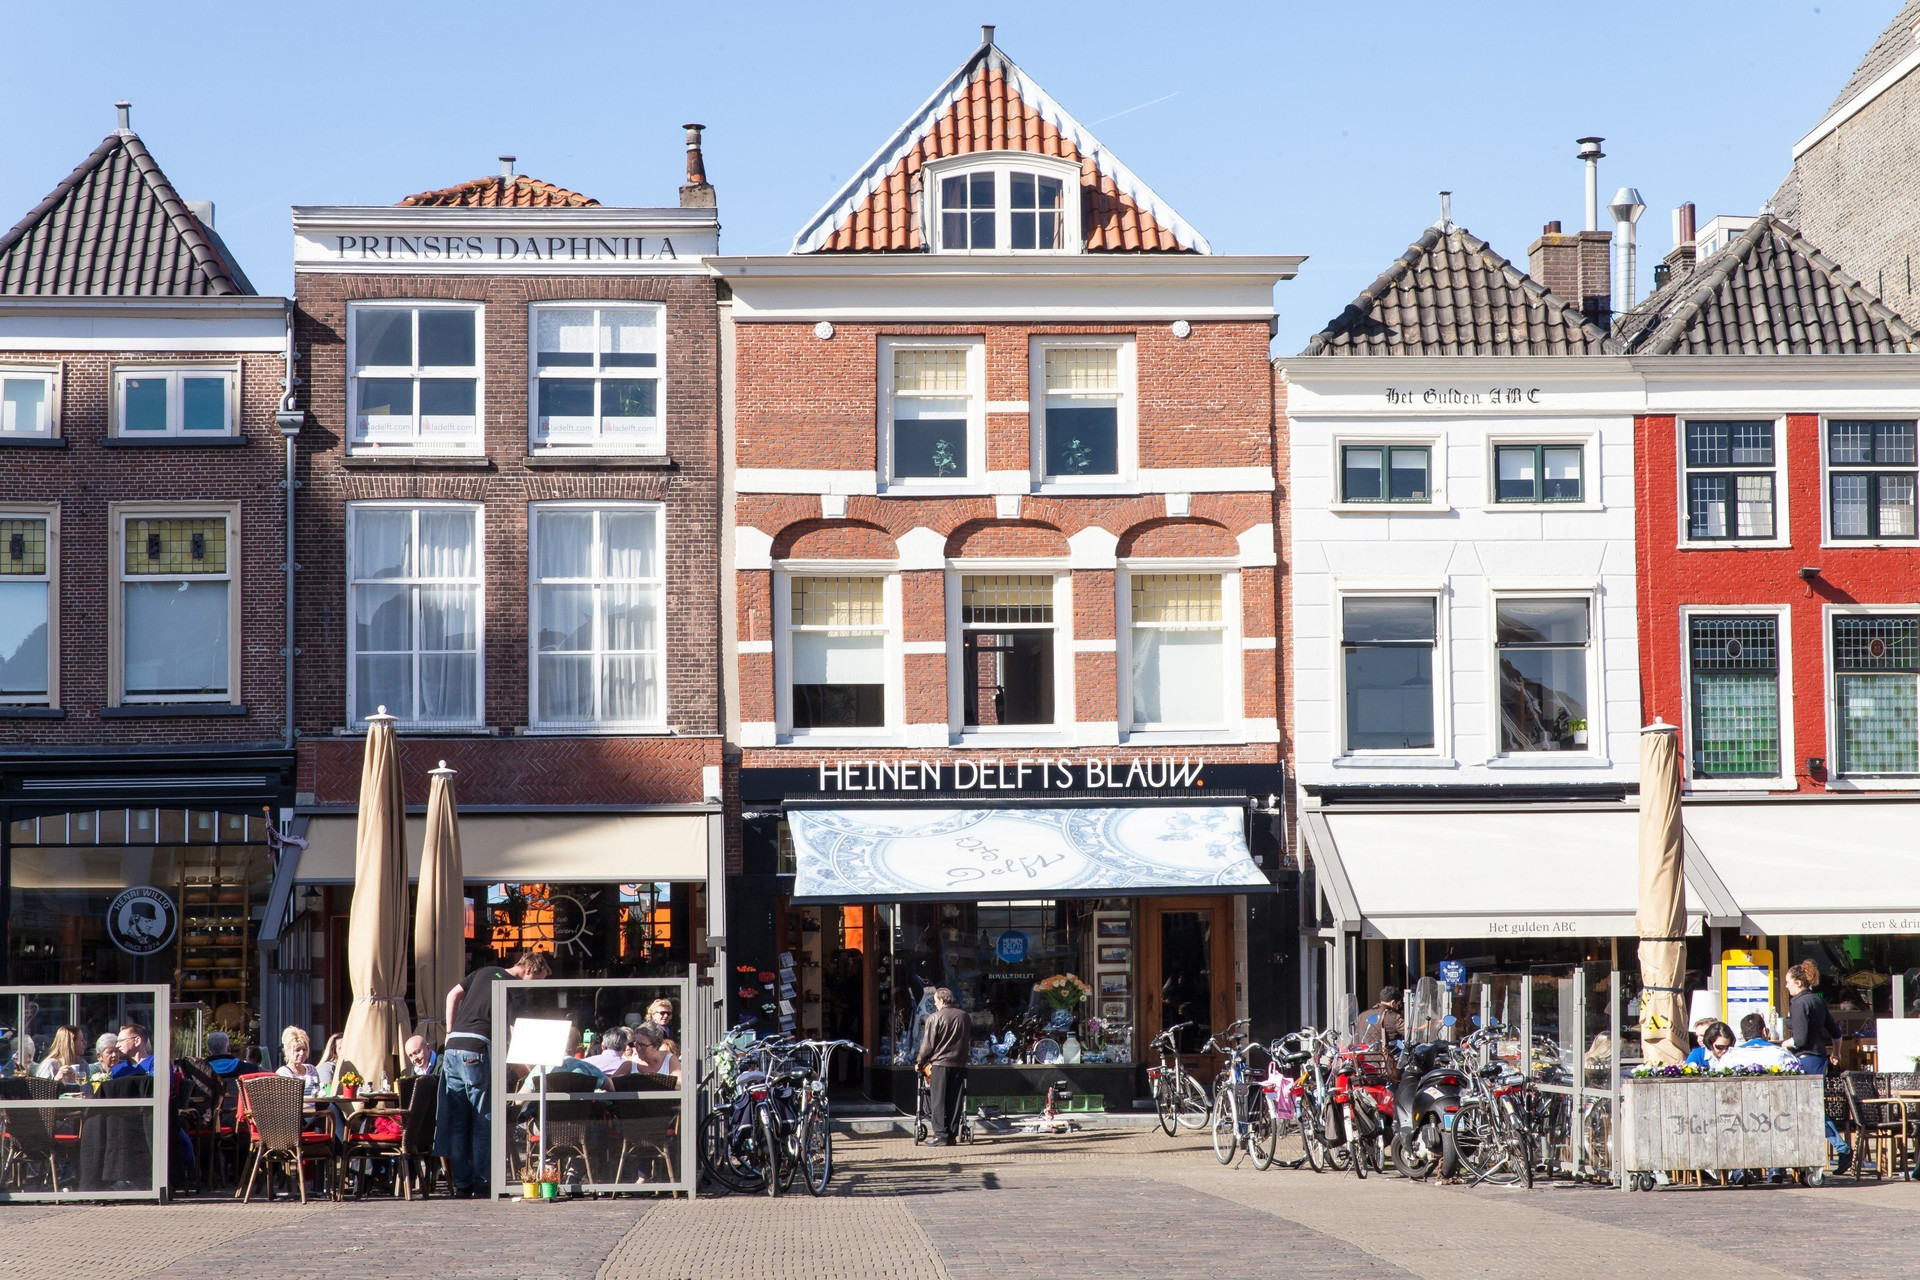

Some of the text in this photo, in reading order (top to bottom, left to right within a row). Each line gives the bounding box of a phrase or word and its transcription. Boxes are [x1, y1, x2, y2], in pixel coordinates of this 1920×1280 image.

[335, 235, 679, 260] PRINSES DAPHNILA
[1385, 387, 1413, 404] Het
[1423, 387, 1479, 404] Gulden
[819, 760, 940, 791] HEINEN
[954, 758, 1074, 790] DELFTS
[114, 889, 171, 910] HENRI WILLIG
[1489, 921, 1576, 934] Het gulden ABC
[1861, 920, 1886, 929] eten
[1720, 1112, 1794, 1134] ABC
